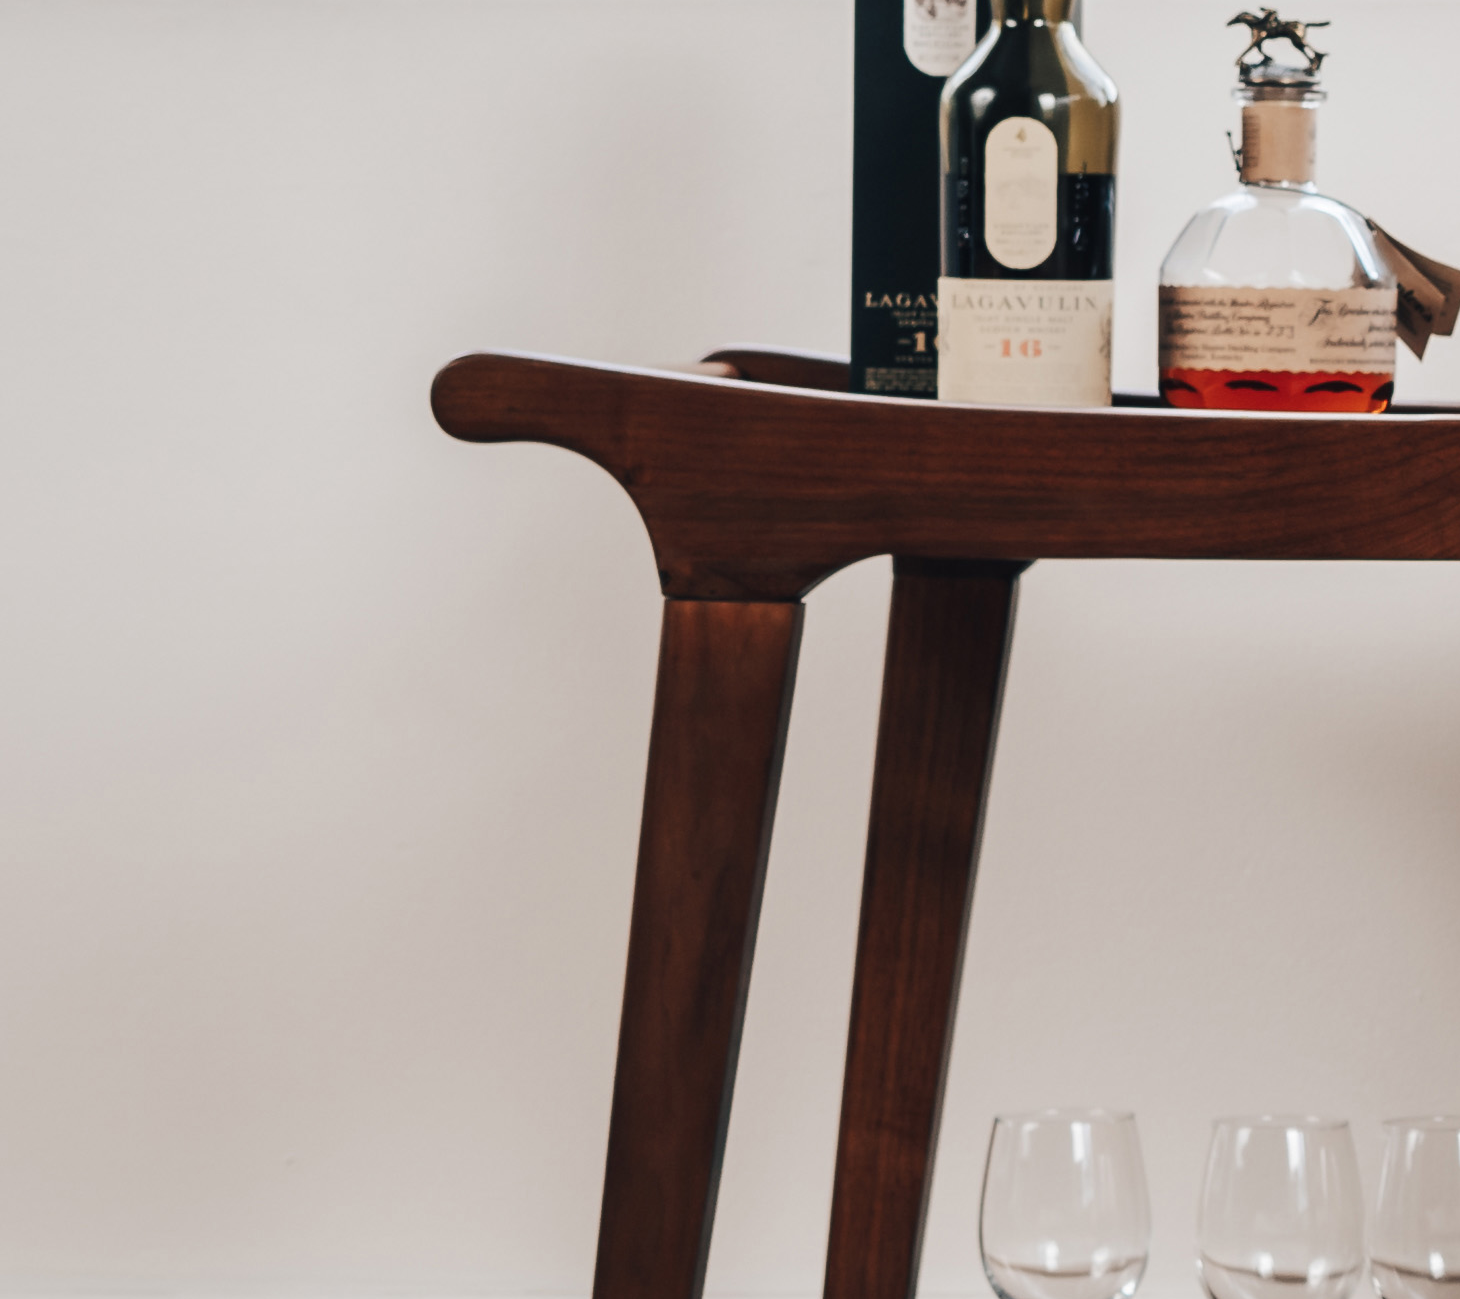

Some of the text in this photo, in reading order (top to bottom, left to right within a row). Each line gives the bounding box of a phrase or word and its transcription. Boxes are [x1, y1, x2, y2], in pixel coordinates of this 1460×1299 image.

[952, 294, 1097, 311] LAGAVULIN
[913, 331, 938, 352] 1
[1000, 339, 1043, 358] 16
